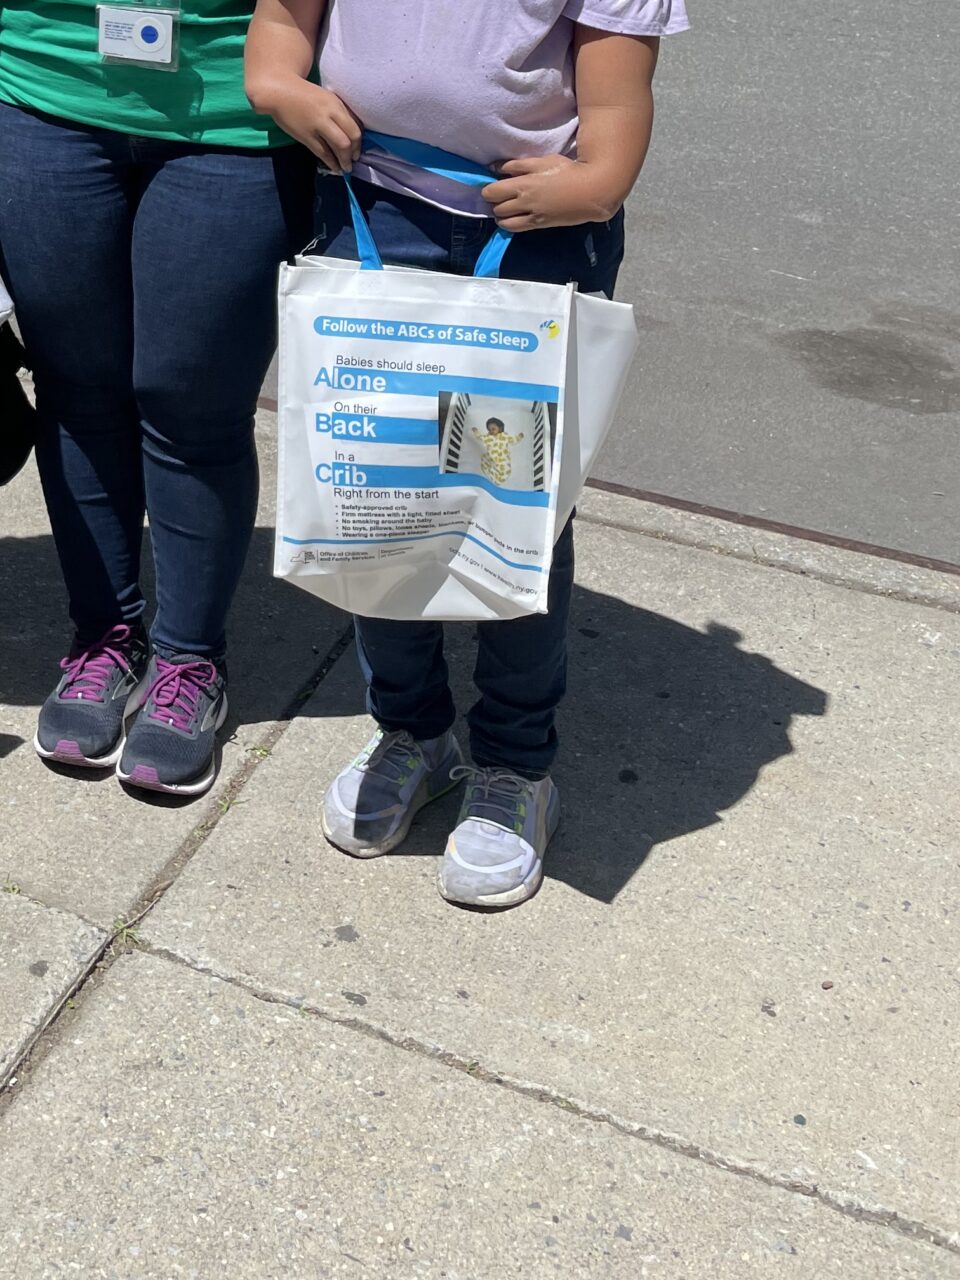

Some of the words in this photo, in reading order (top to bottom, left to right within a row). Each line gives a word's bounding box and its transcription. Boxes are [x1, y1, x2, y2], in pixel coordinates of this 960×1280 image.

[322, 319, 368, 334] Follow
[371, 322, 395, 336] the
[397, 324, 435, 339] ABCs
[438, 327, 453, 340] of
[455, 328, 487, 342] Safe
[490, 331, 529, 350] Sleep
[336, 355, 374, 368] Babies
[376, 358, 413, 371] should
[416, 362, 446, 374] sleep
[313, 366, 387, 392] Alone
[334, 401, 350, 412] On
[353, 403, 378, 415] their
[315, 412, 377, 438] Back
[335, 451, 345, 461] In
[348, 453, 355, 462] a
[315, 463, 367, 486] Crib
[333, 487, 363, 500] Right
[365, 489, 391, 499] from
[394, 490, 412, 499] the
[414, 490, 440, 499] start
